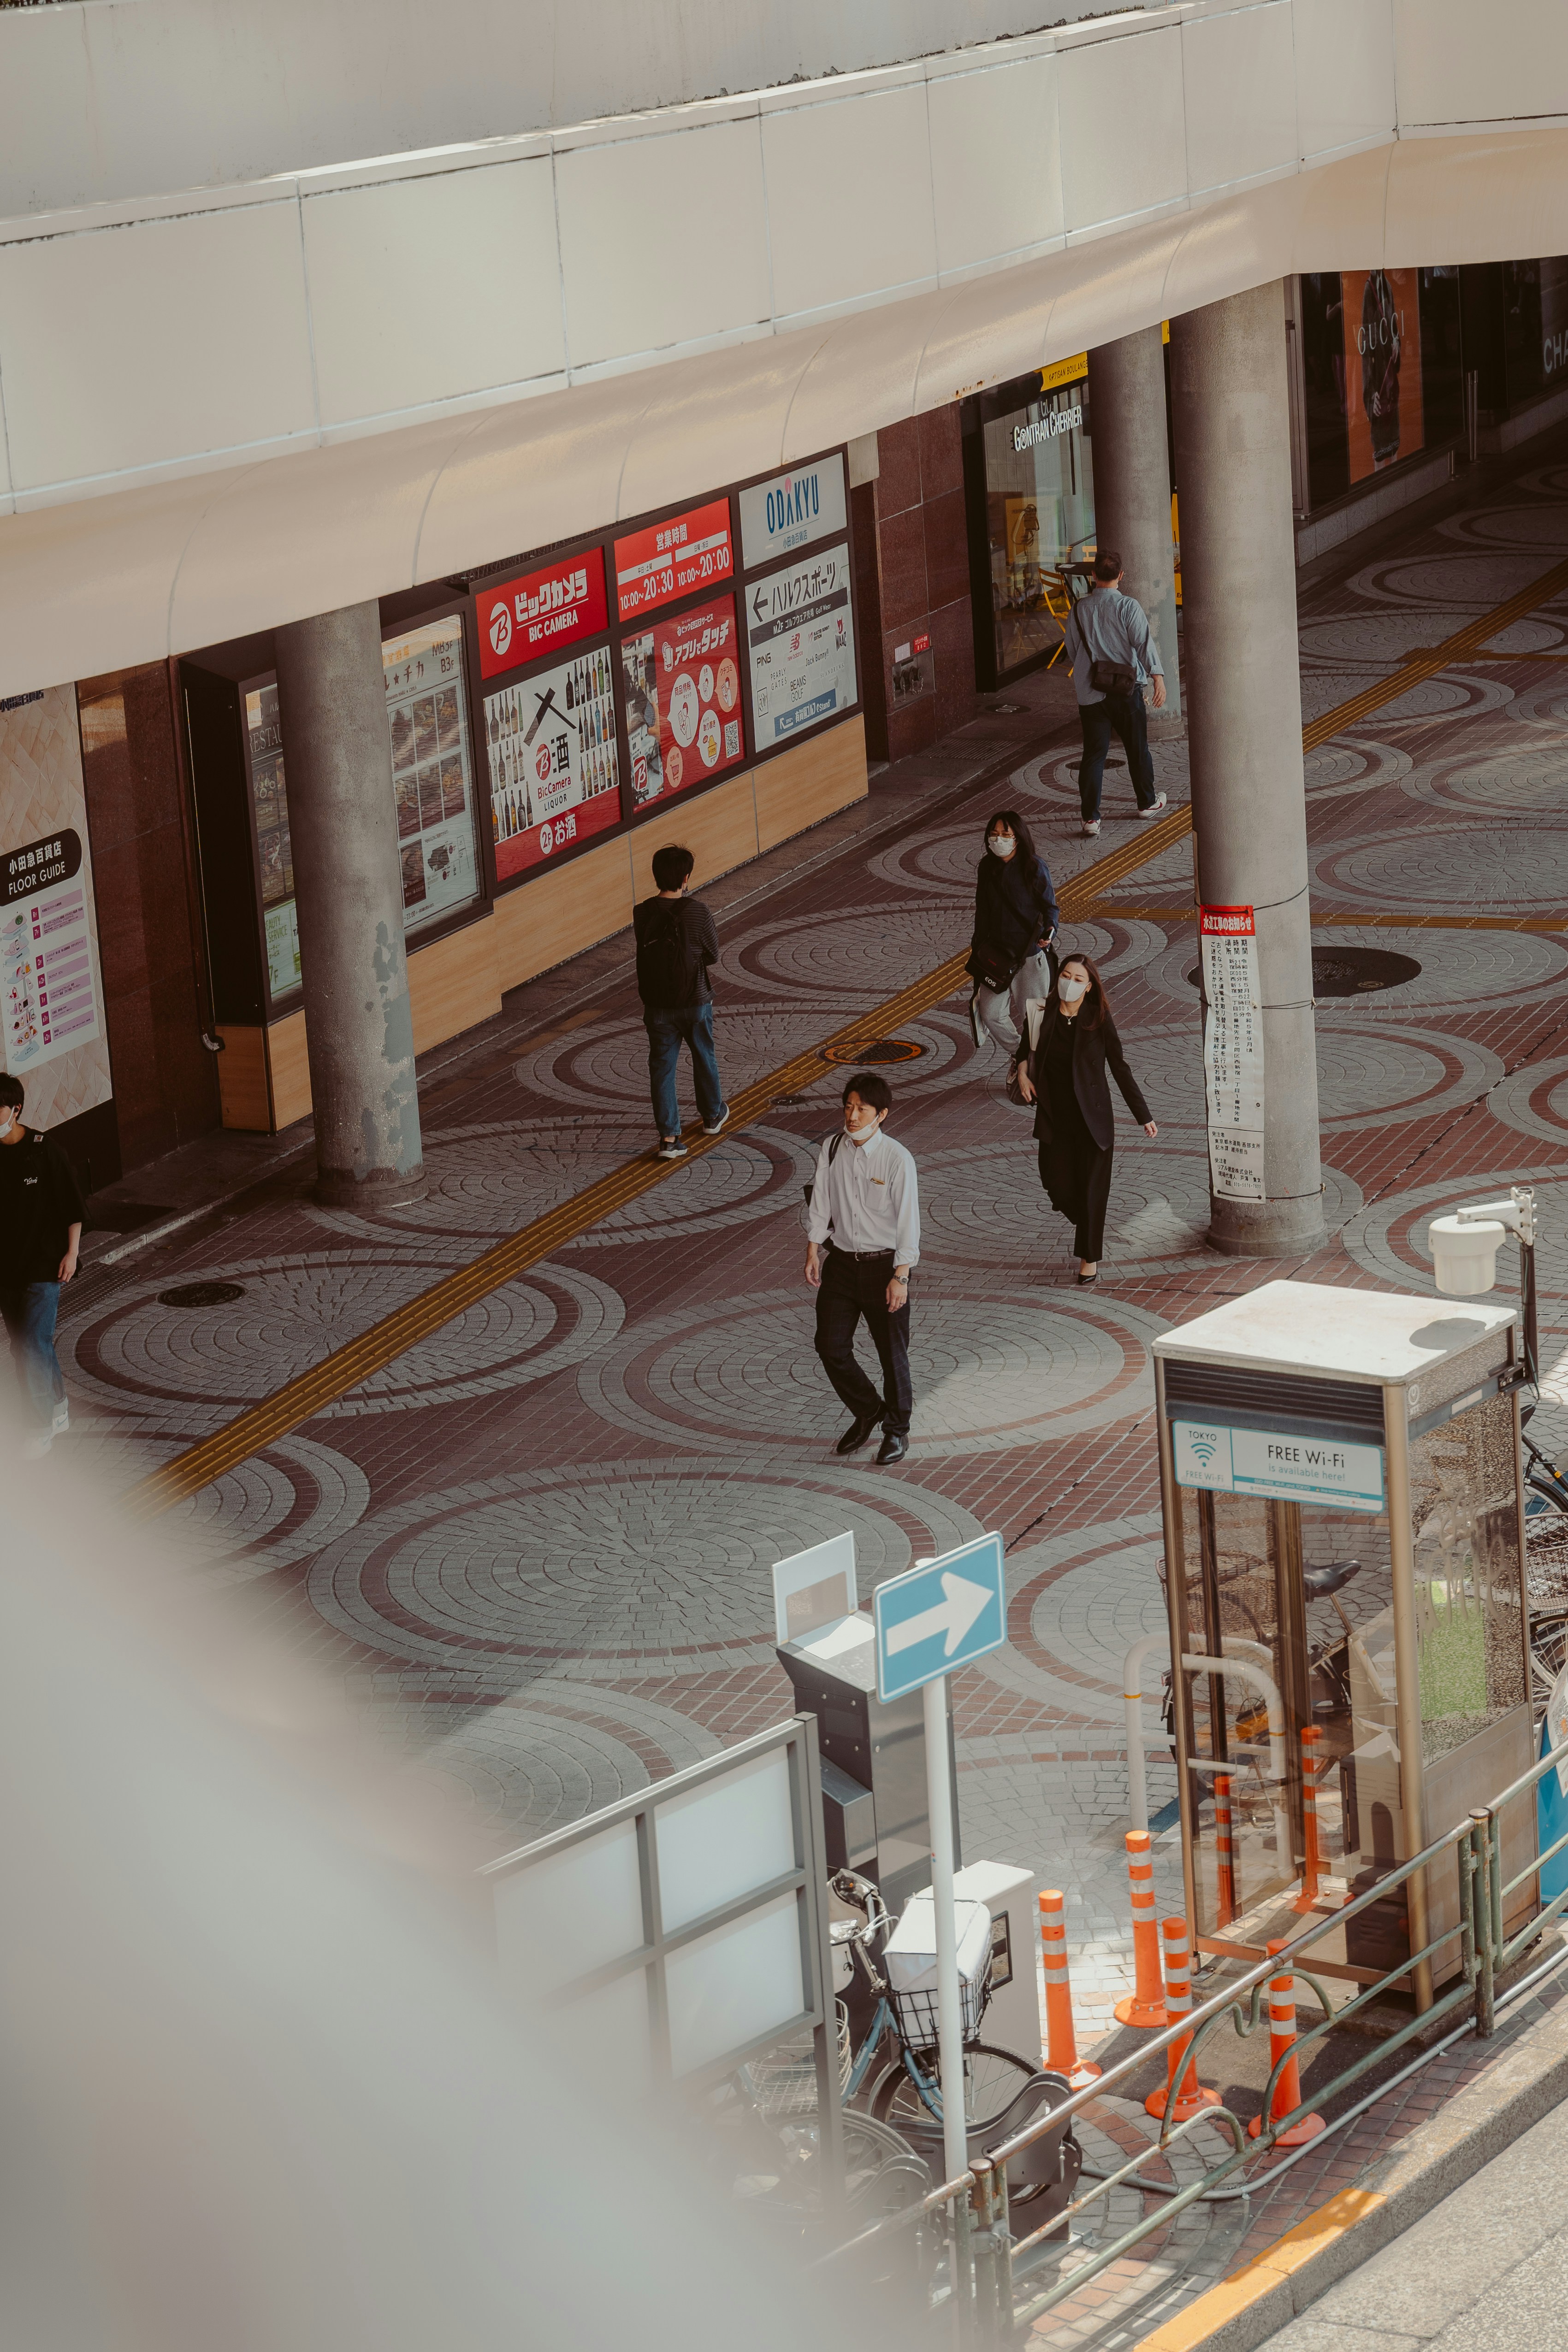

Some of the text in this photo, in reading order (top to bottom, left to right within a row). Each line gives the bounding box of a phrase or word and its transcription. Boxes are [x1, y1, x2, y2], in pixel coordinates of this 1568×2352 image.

[1357, 310, 1404, 355] GUCCI
[1049, 369, 1066, 382] ARTISAN
[1013, 405, 1083, 452] GONTRAN CHERRIER
[767, 474, 819, 534] ODAKYU
[656, 523, 687, 551] 営業時間
[783, 530, 808, 549] 小田急百貨店
[515, 568, 587, 622] ビックカメラ
[772, 561, 835, 615] ハルクスポーツ
[529, 609, 579, 643] BIC CAMERA
[773, 620, 784, 635] M2F
[785, 608, 814, 629] ゴルフウェア売場
[823, 603, 831, 612] Wear
[675, 620, 729, 666] アプリでタッチ
[835, 631, 847, 652] WAAC
[756, 652, 771, 668] PING
[793, 650, 804, 660] balance
[805, 656, 814, 667] Jack
[441, 656, 454, 673] B3F
[720, 664, 733, 676] クチコミ
[770, 667, 787, 681] PEARLY
[790, 674, 807, 691] BEAMS
[674, 681, 692, 697] 商品情報
[771, 677, 787, 691] GATES
[791, 688, 804, 703] GOLF
[703, 720, 716, 732] 取り置き
[538, 776, 572, 800] BicCamera
[544, 793, 568, 811] LIQUOR
[542, 813, 577, 849] 2F お酒
[9, 840, 62, 875] 小田急百貨店
[9, 861, 65, 895] FLOOR GUIDE
[1203, 915, 1252, 931] 水道工事のお知らせ
[268, 925, 288, 943] SERVICE
[1225, 939, 1231, 955] 場所
[1233, 939, 1240, 955] 時間
[1241, 939, 1248, 955] 期間
[1215, 1139, 1241, 1147] 東京都水道局
[1217, 1164, 1253, 1176] リアル建設株式会社
[1188, 1430, 1217, 1441] TOKYO
[1268, 1445, 1344, 1468] FREE Wi-Fi
[1185, 1470, 1224, 1483] FREE Wi-Fi
[1268, 1463, 1345, 1481] is available here!
